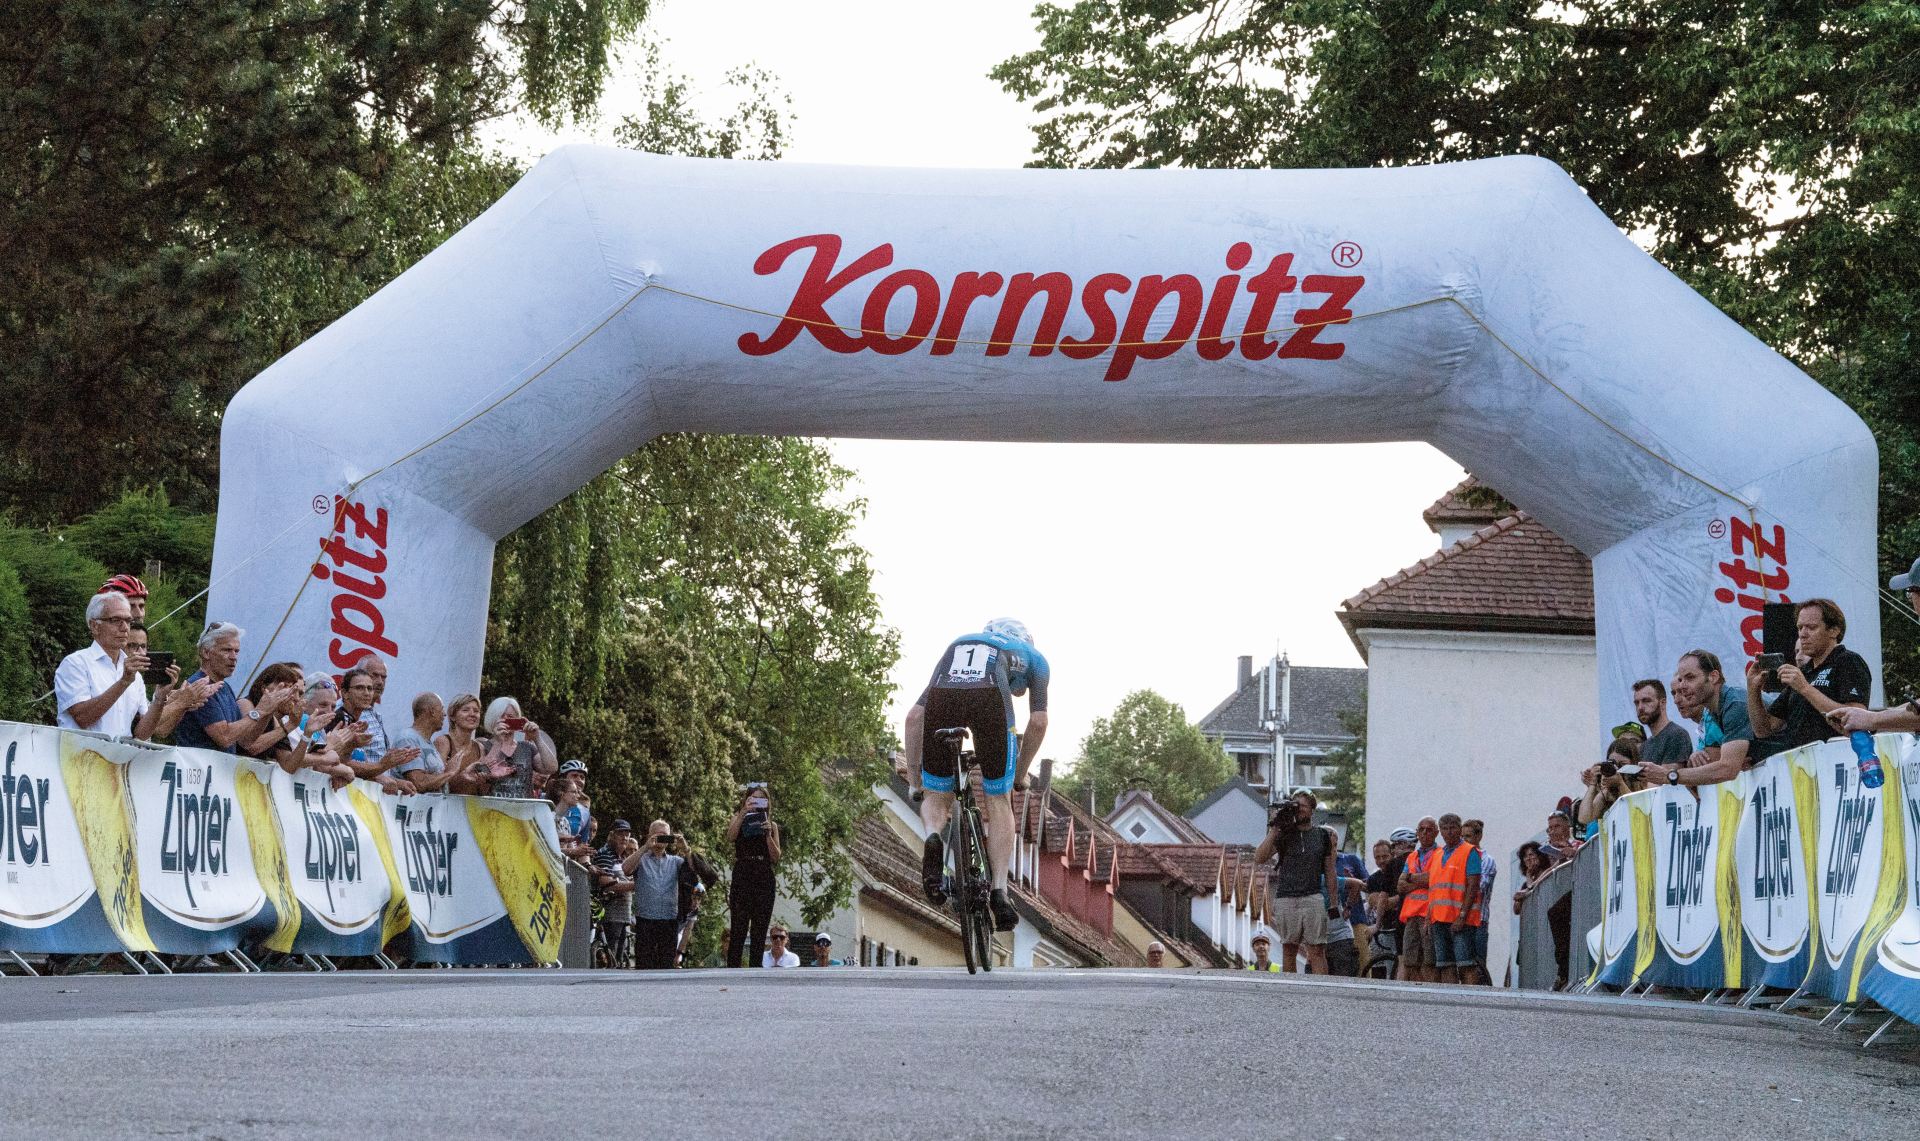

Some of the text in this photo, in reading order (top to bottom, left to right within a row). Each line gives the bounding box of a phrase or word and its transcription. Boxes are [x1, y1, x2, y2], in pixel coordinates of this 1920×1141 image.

[737, 234, 1365, 381] Kornspitz
[311, 494, 398, 701] spitz
[966, 647, 975, 667] 1
[0, 740, 50, 867] fer
[160, 761, 232, 911] Zipfer
[186, 768, 202, 785] 1858
[293, 782, 363, 916] Zipfer
[395, 803, 459, 925] Zipfer
[1665, 801, 1713, 945] Zipfer
[1750, 775, 1795, 941] Zipfer
